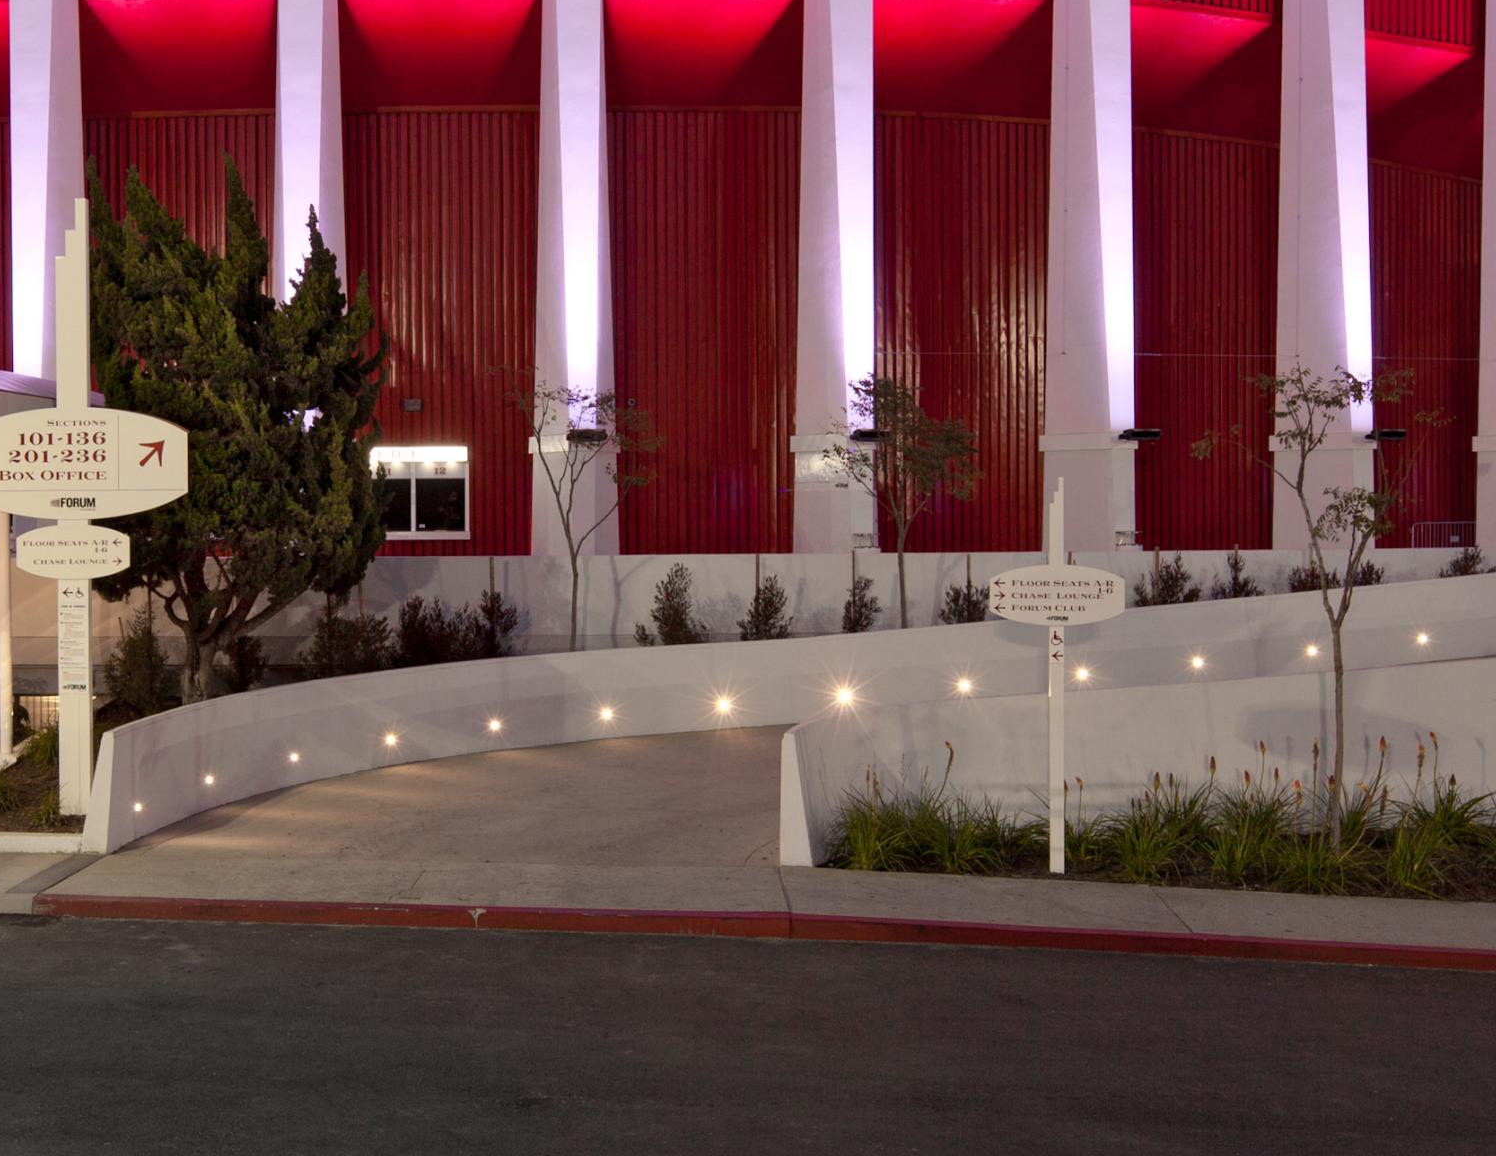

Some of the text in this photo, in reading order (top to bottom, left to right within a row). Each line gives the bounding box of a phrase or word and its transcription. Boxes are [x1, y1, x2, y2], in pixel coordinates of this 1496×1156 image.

[19, 432, 106, 446] 101-136
[9, 449, 106, 463] 201-236
[0, 470, 107, 481] BOX OFFICE
[60, 497, 96, 508] FORUM
[1011, 592, 1104, 600] CHASE LOUNGE
